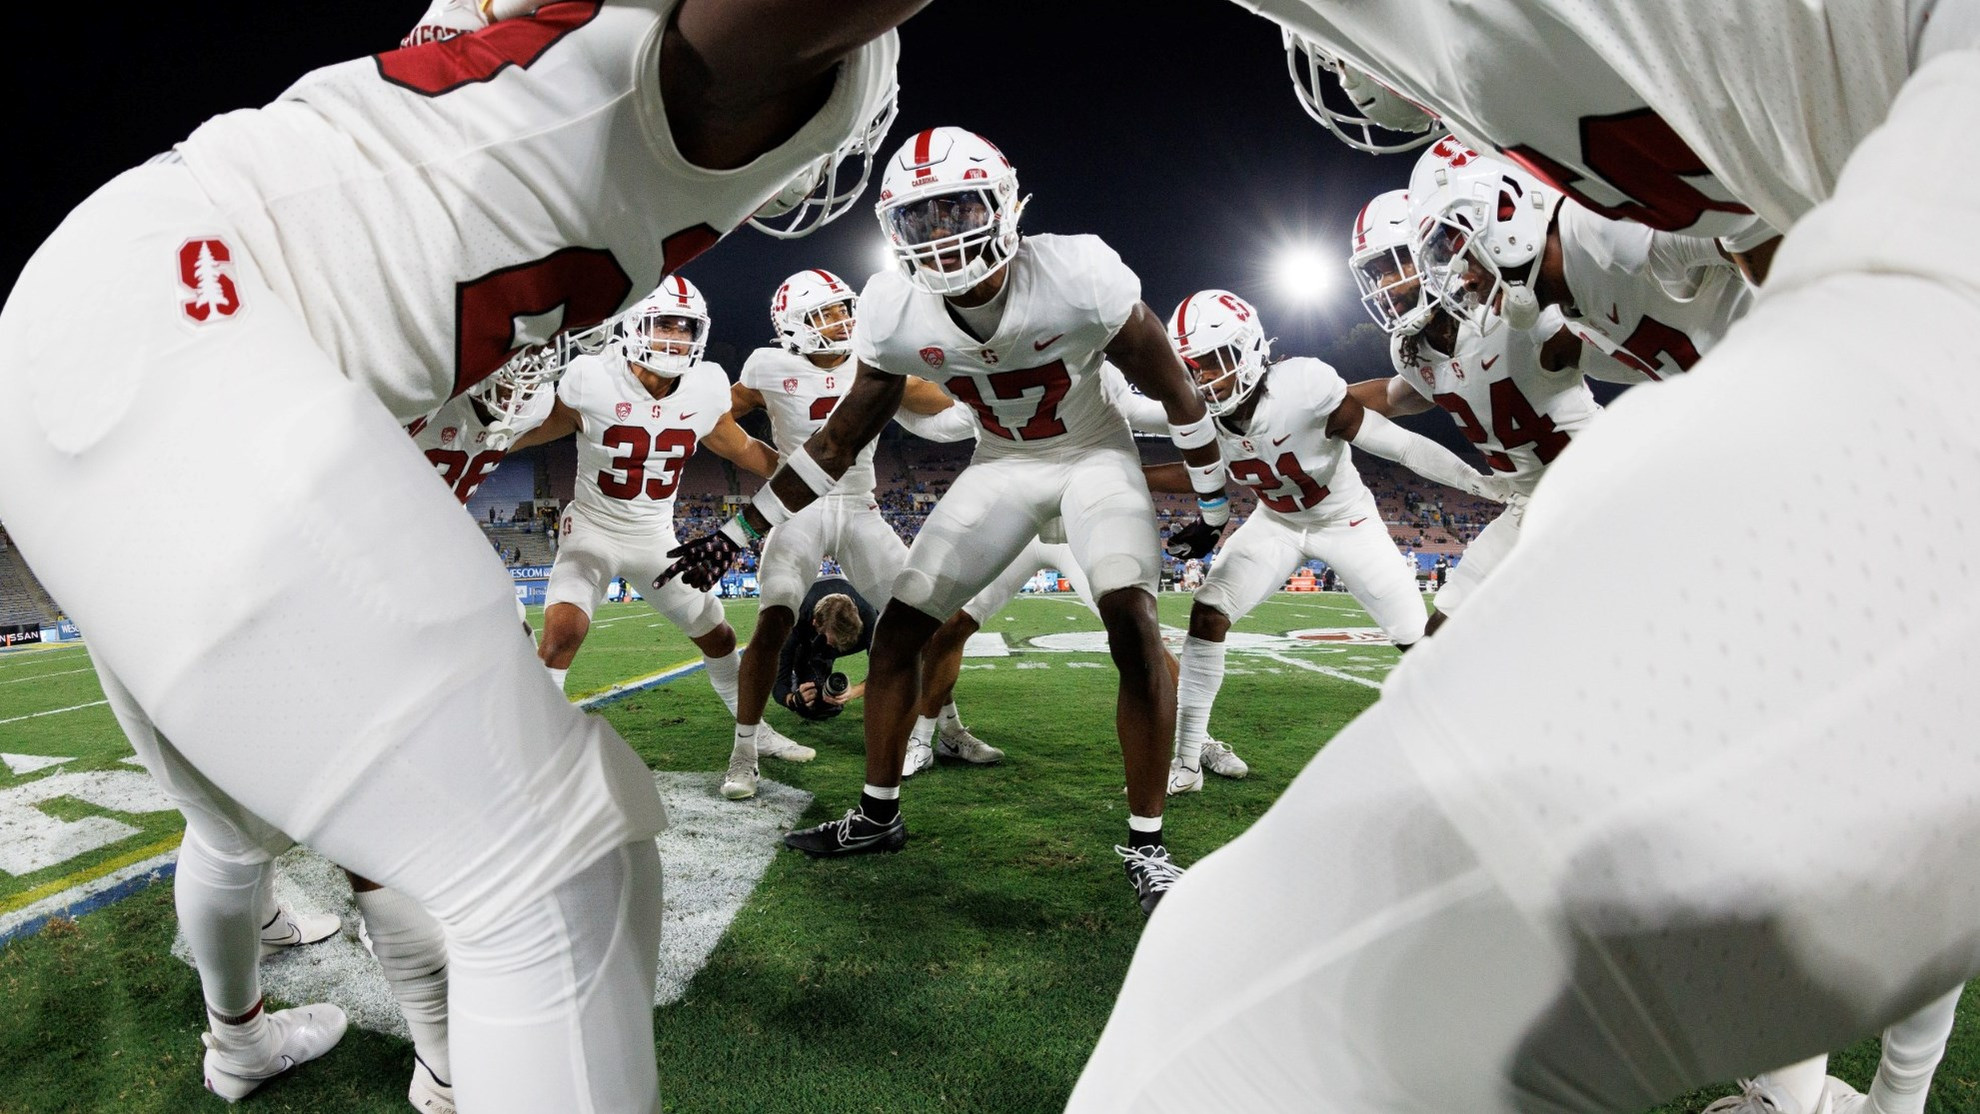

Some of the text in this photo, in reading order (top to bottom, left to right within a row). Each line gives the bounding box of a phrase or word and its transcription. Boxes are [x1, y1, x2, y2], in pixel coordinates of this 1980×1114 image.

[180, 240, 240, 321] S
[944, 358, 1072, 442] 17
[1433, 377, 1572, 473] 24
[597, 424, 697, 501] 33
[1229, 451, 1331, 513] 21
[0, 631, 39, 642] NSSAN
